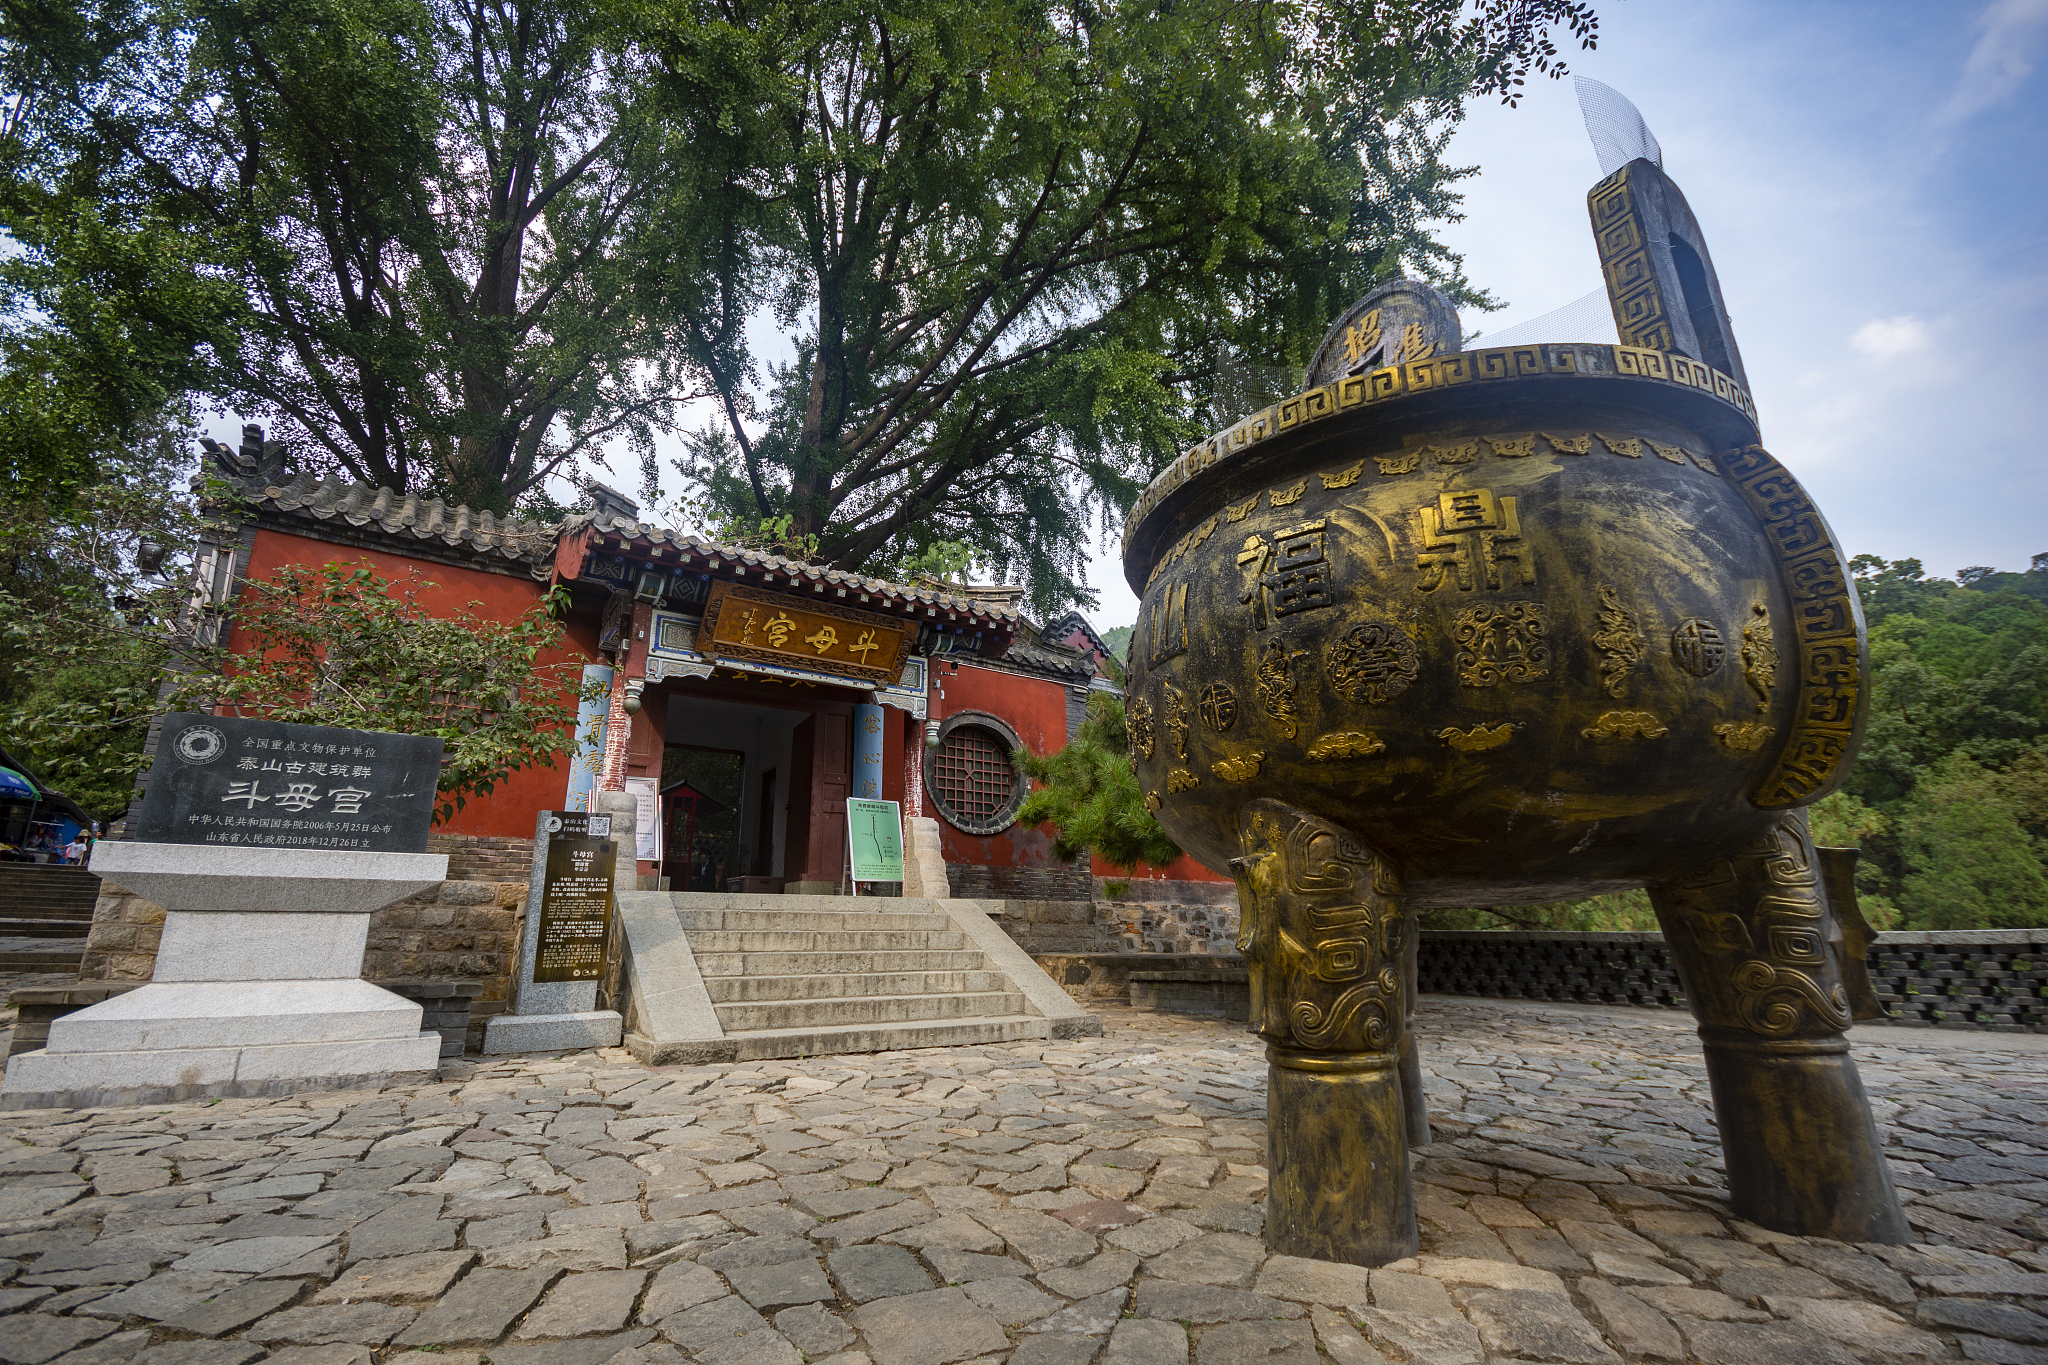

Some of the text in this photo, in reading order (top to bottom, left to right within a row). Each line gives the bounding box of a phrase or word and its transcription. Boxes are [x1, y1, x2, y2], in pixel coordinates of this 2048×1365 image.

[242, 736, 377, 758] 全国重点文物保护单位
[237, 756, 372, 779] 泰山古建筑群
[221, 780, 372, 814] 斗母宫
[188, 814, 393, 834] 中华人民共和国国务院2006年5月25日公布
[206, 831, 371, 848] 山东省人民政府2018年12月26日立
